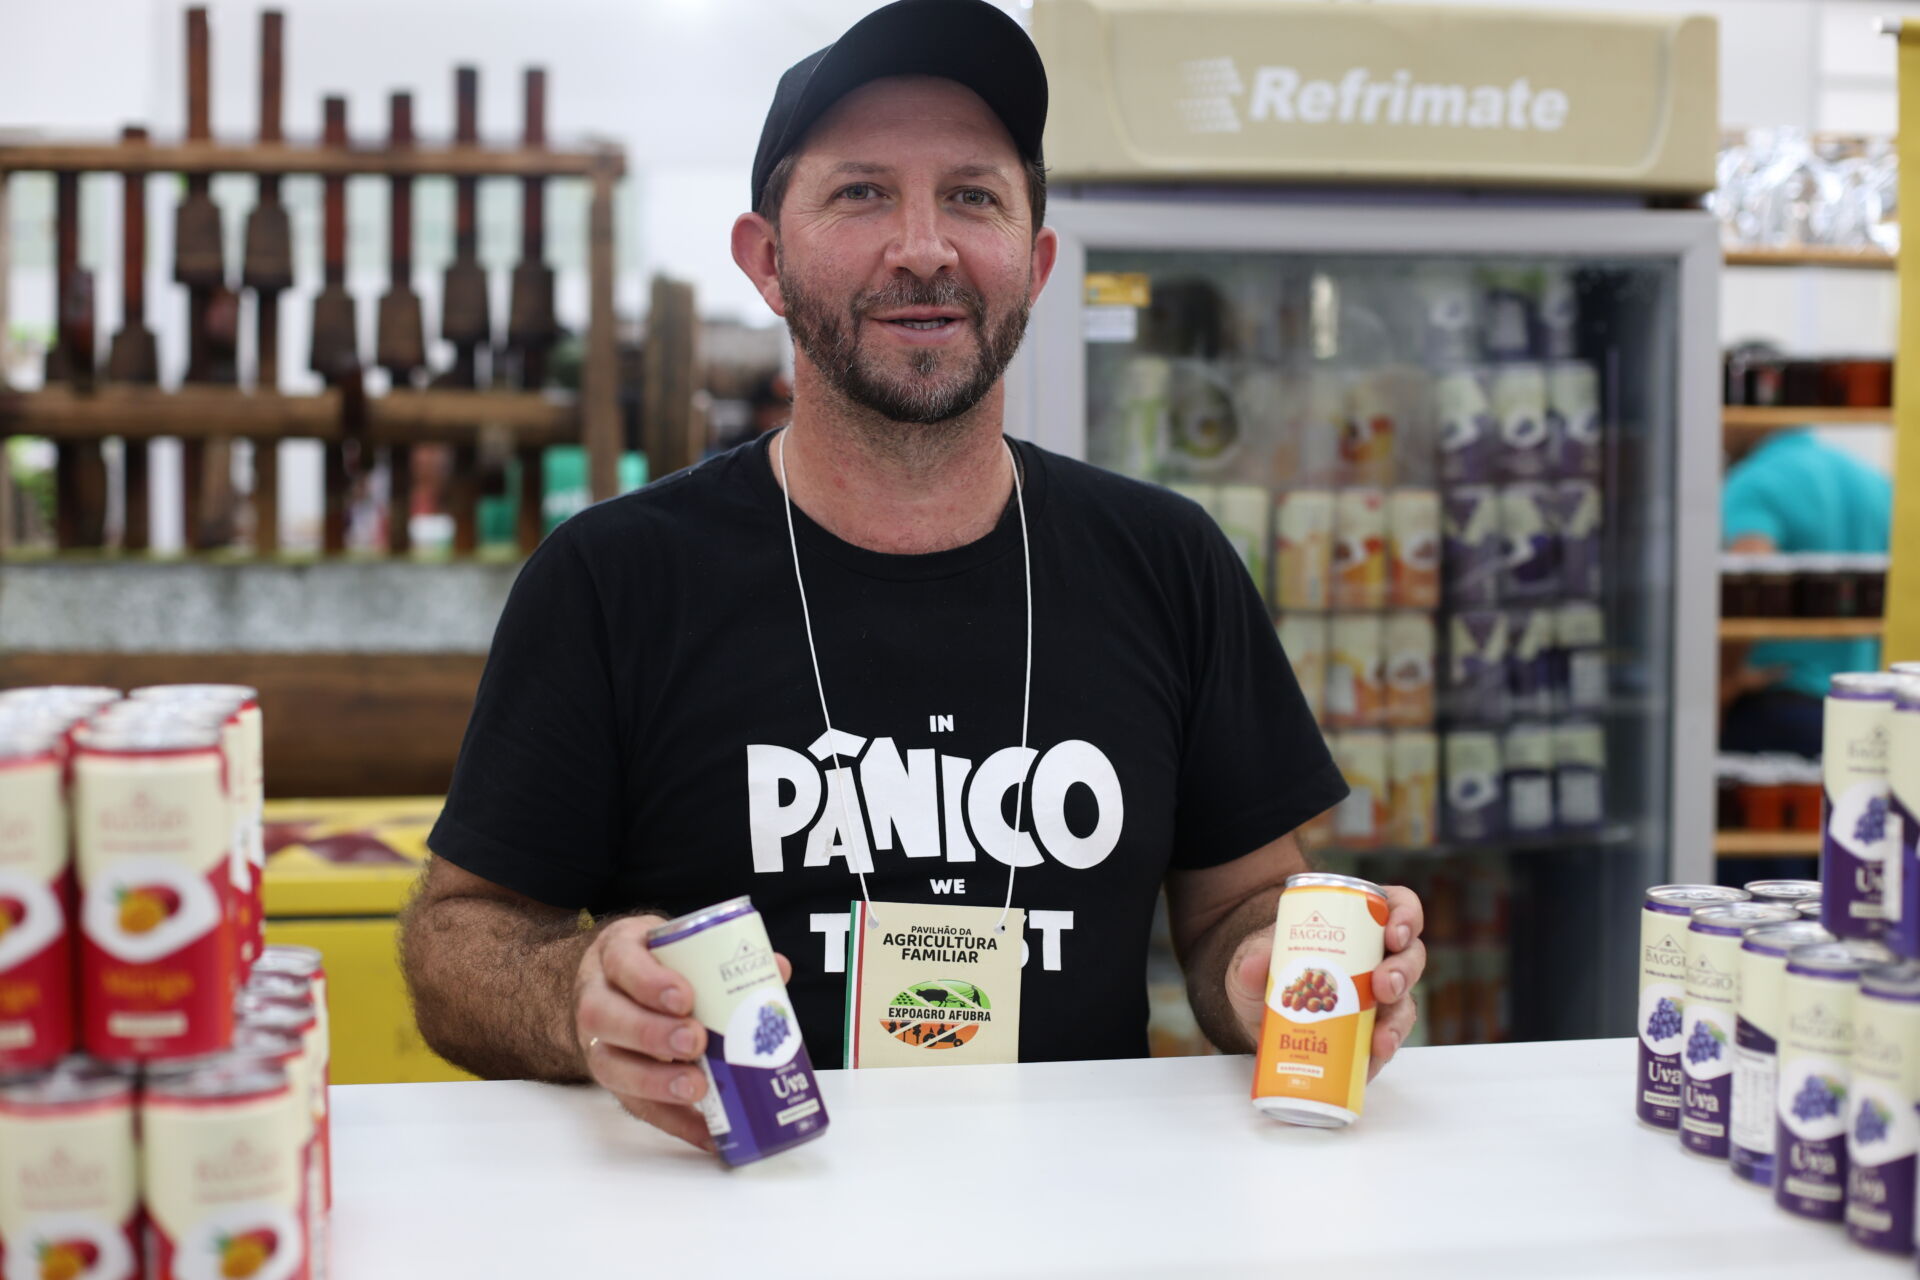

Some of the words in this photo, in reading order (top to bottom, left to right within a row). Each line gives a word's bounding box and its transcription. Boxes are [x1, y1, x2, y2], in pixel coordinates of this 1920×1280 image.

[1250, 66, 1569, 131] Refrimate
[930, 715, 954, 732] IN
[746, 728, 1124, 873] PÂNICO
[930, 879, 966, 894] WE
[911, 925, 957, 935] PAVILHÃO
[959, 928, 972, 936] DA
[1289, 927, 1345, 942] BAGGIO
[882, 933, 998, 950] AGRICULTURA
[901, 948, 979, 963] FAMILIAR
[1645, 948, 1686, 968] BAGGI
[888, 1007, 945, 1020] EXPOAGRO
[948, 1010, 991, 1022] AFUBRA
[1279, 1033, 1328, 1055] Butiá
[1648, 1061, 1682, 1085] Uva
[770, 1072, 809, 1099] Uva
[1686, 1085, 1720, 1113] Uva
[1790, 1142, 1837, 1175] Uva
